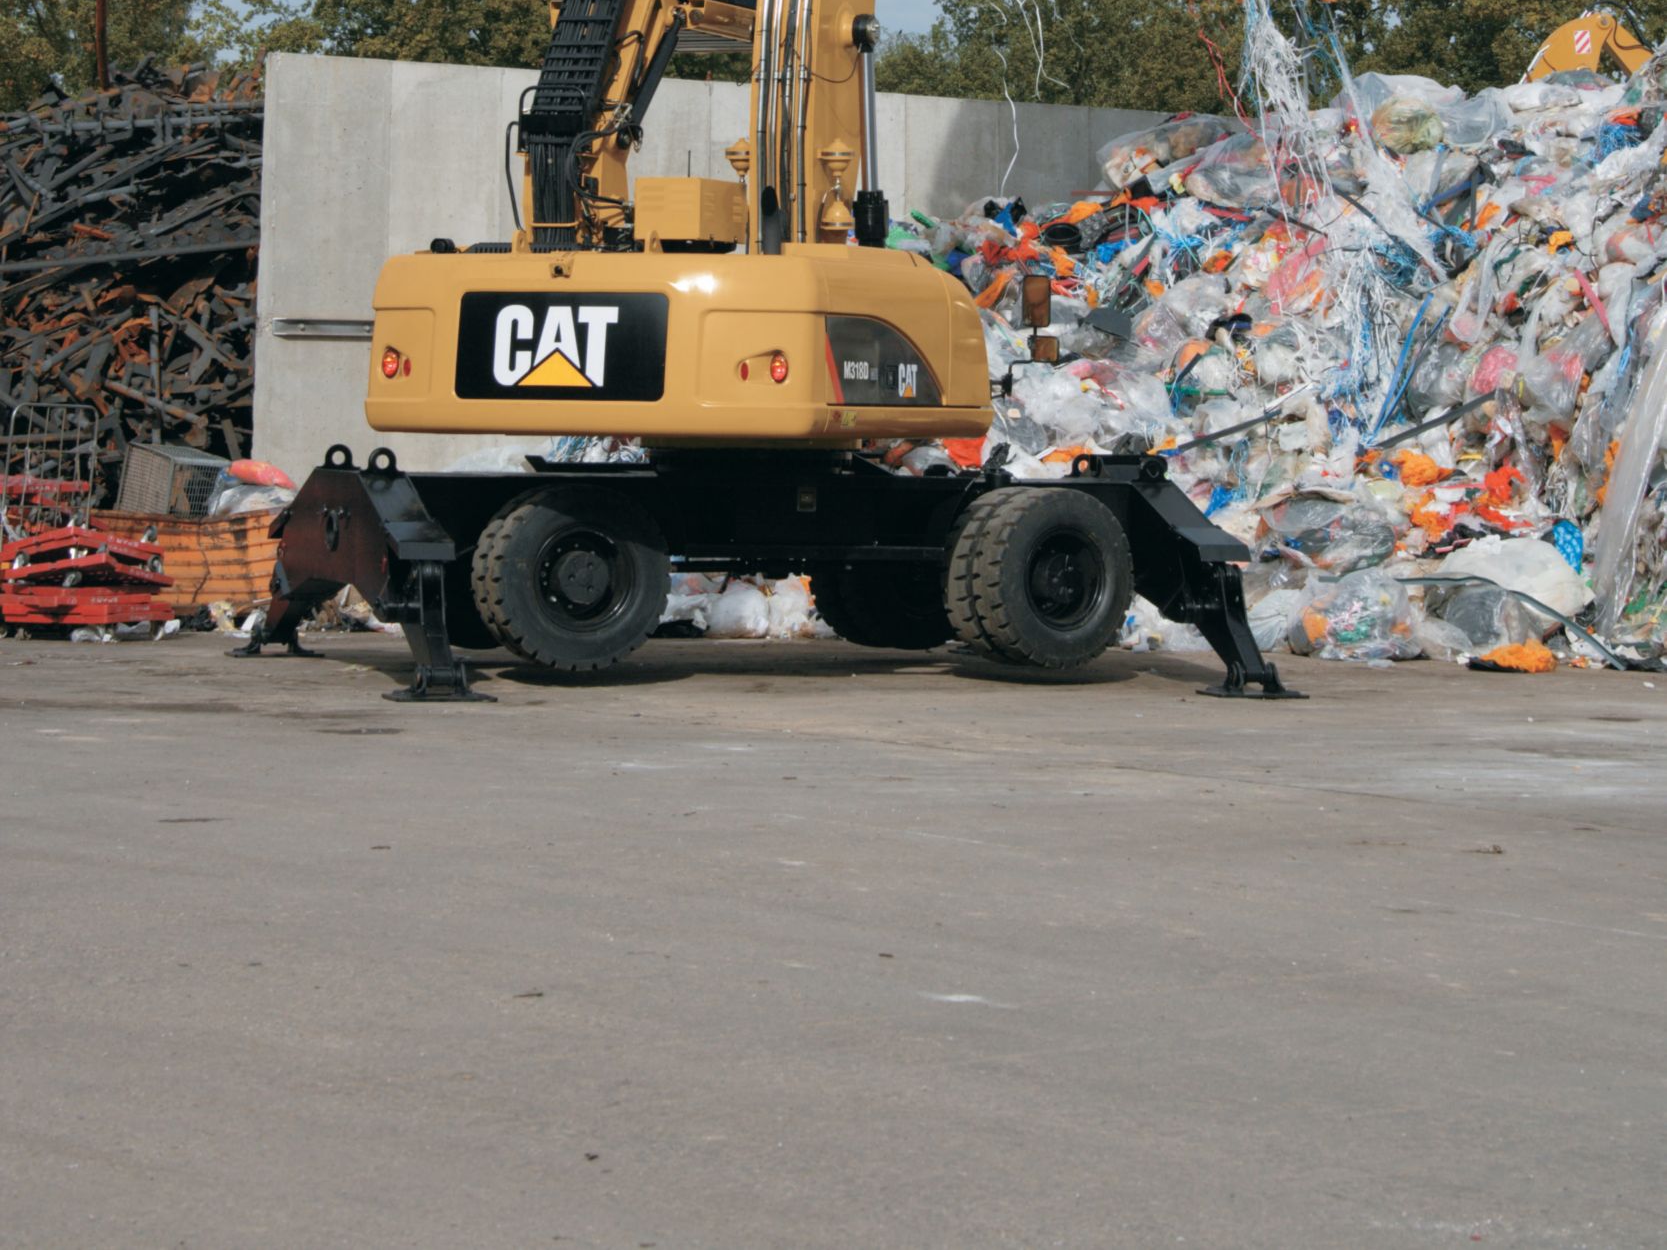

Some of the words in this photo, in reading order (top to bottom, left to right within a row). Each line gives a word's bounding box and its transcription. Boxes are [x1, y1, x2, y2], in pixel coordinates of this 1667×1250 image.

[493, 304, 619, 387] CAT
[843, 360, 869, 380] M318D
[898, 363, 918, 398] CAT
